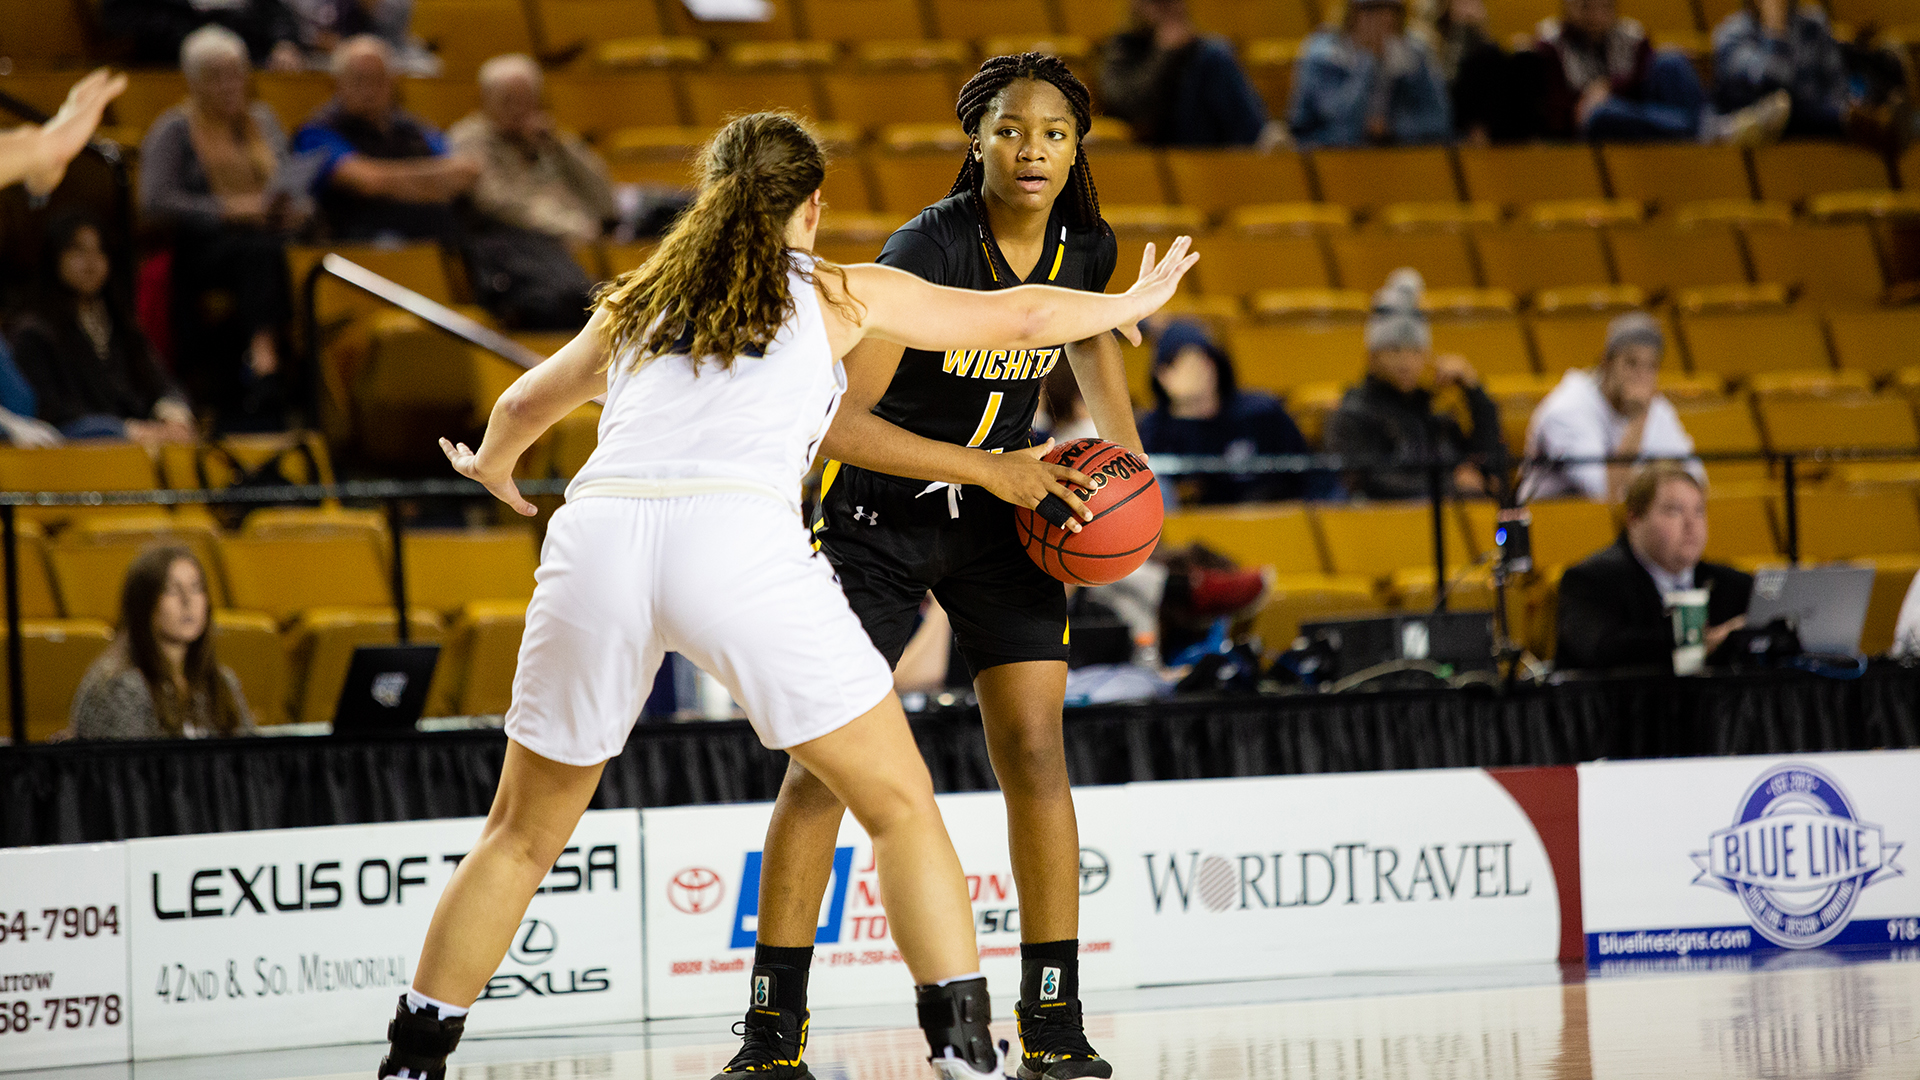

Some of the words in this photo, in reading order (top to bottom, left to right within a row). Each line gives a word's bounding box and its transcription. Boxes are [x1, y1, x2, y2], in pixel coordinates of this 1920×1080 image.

[942, 348, 1061, 381] WICHITA
[965, 391, 1004, 448] 1
[1724, 824, 1796, 878] BLUE
[1808, 824, 1867, 877] LINE
[152, 861, 343, 920] LEXUS
[358, 856, 429, 905] OF
[1141, 842, 1532, 915] WORLDTRAVEL
[1599, 929, 1751, 956] bluelinesigns.com
[0, 972, 54, 993] rrow
[225, 959, 245, 998] &
